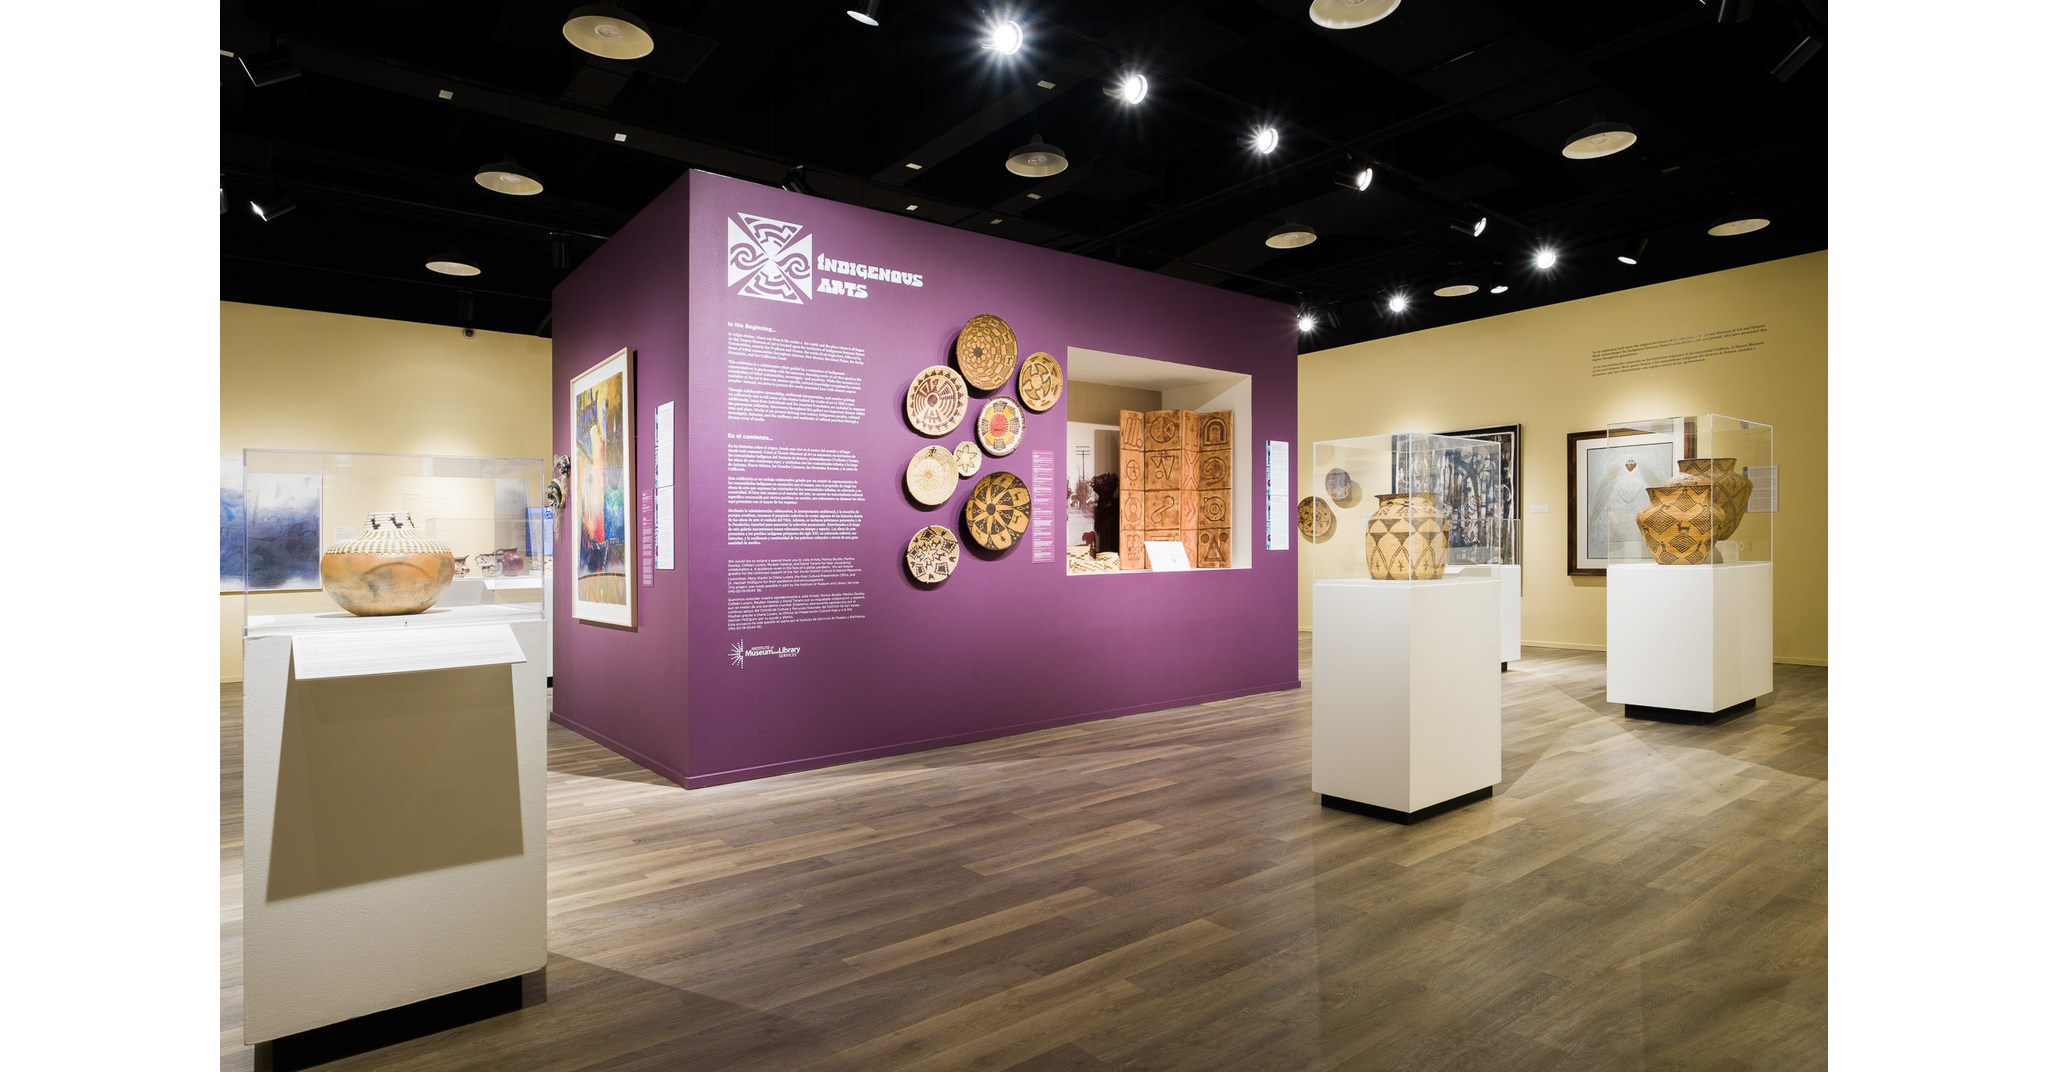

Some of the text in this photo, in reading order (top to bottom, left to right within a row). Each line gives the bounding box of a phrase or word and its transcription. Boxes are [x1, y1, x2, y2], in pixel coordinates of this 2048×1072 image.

[817, 253, 924, 288] INDIGENOUS
[816, 277, 869, 299] ARTS
[744, 649, 774, 657] Museum
[778, 646, 801, 655] Library
